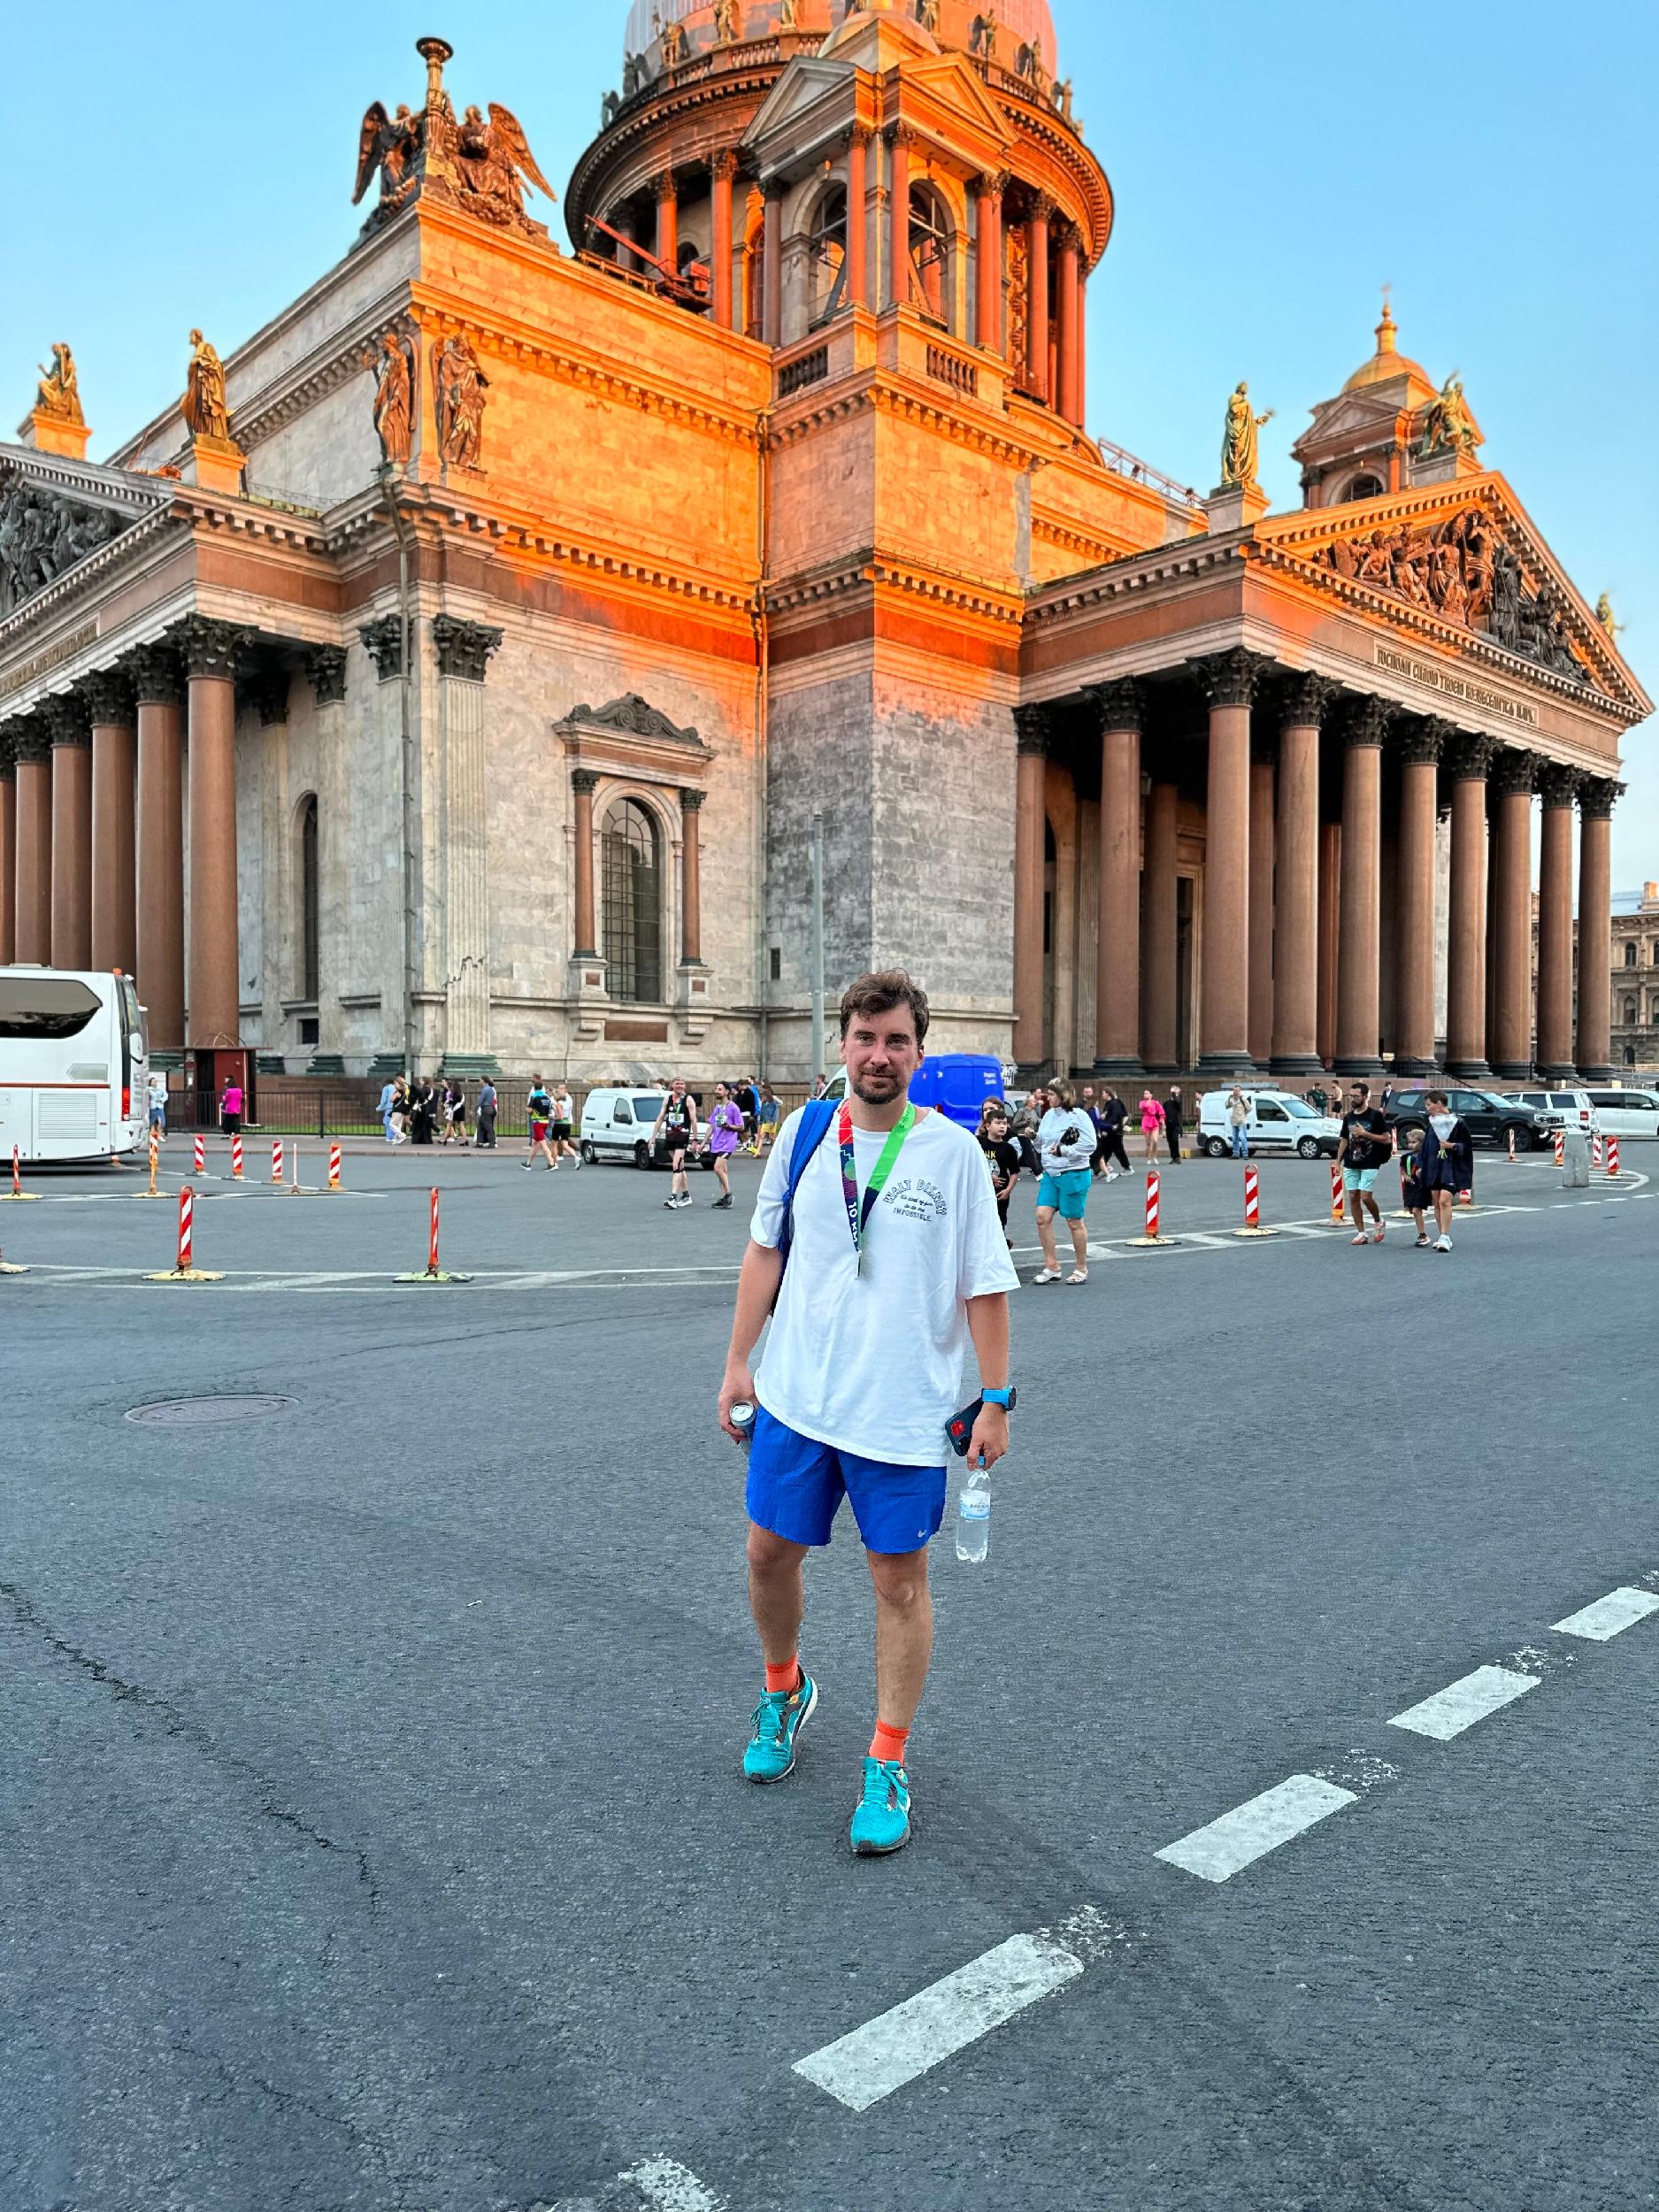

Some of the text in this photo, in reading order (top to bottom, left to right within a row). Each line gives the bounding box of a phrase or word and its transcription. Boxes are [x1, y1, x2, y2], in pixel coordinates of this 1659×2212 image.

[883, 1179, 947, 1216] WALT DISNEY
[848, 1201, 858, 1218] 10
[893, 1207, 933, 1222] IMPOSSIBLE
